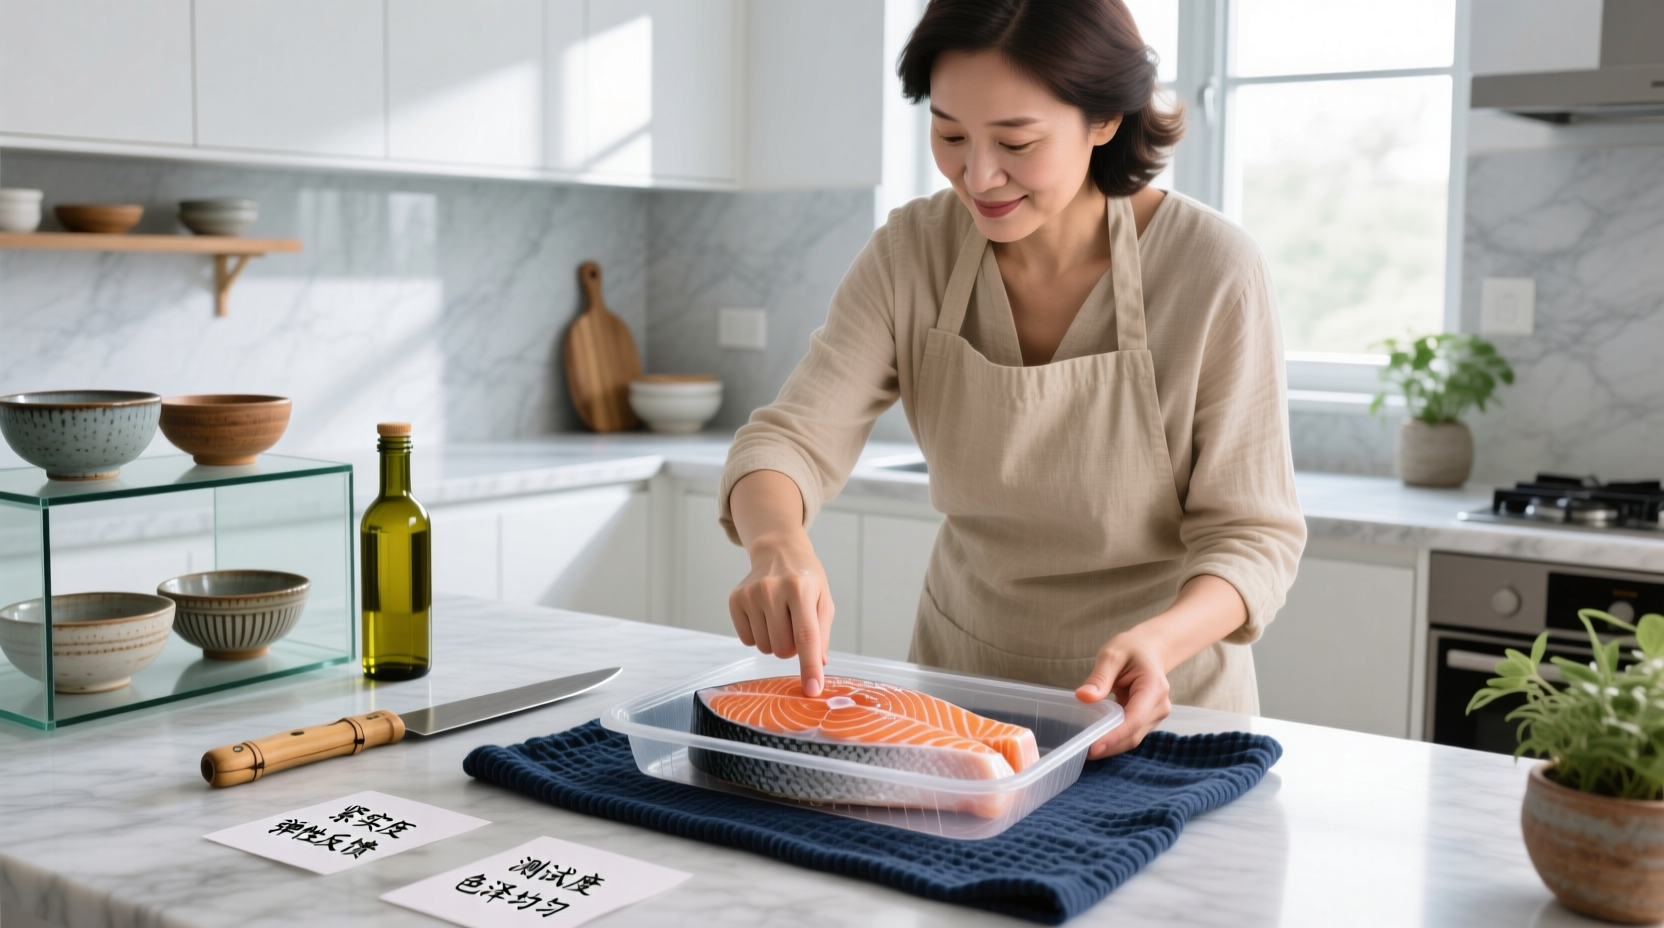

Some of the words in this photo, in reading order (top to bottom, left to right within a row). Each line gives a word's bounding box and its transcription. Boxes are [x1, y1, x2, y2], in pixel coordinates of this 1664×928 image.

[268, 818, 379, 859] 弹性反馈
[455, 873, 570, 918] 色泽均匀
[508, 856, 605, 896] 测试度
